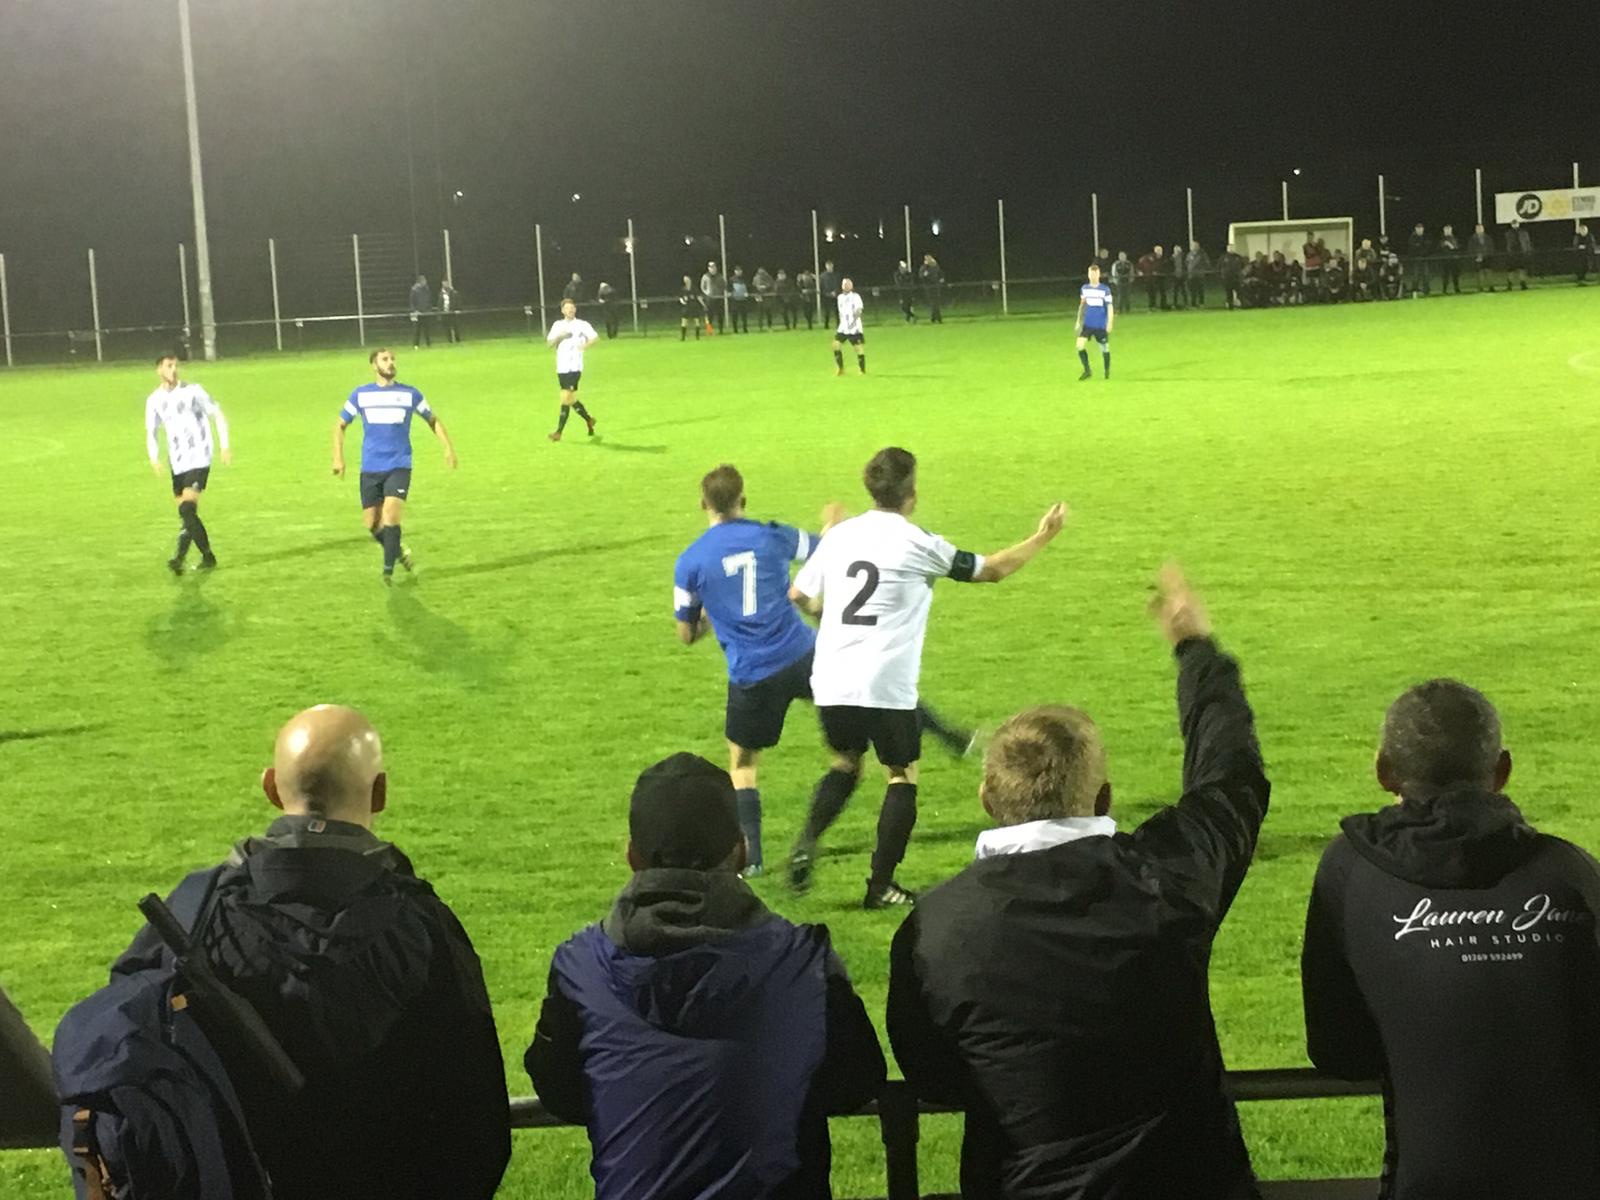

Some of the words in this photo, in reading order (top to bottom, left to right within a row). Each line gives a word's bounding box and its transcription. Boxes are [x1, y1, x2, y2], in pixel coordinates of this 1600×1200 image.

[1518, 198, 1541, 215] JD
[721, 550, 758, 617] 7
[841, 560, 880, 626] 2
[1393, 897, 1505, 940] Lauren
[1430, 935, 1478, 949] HAIR
[1491, 932, 1565, 946] STUDIO
